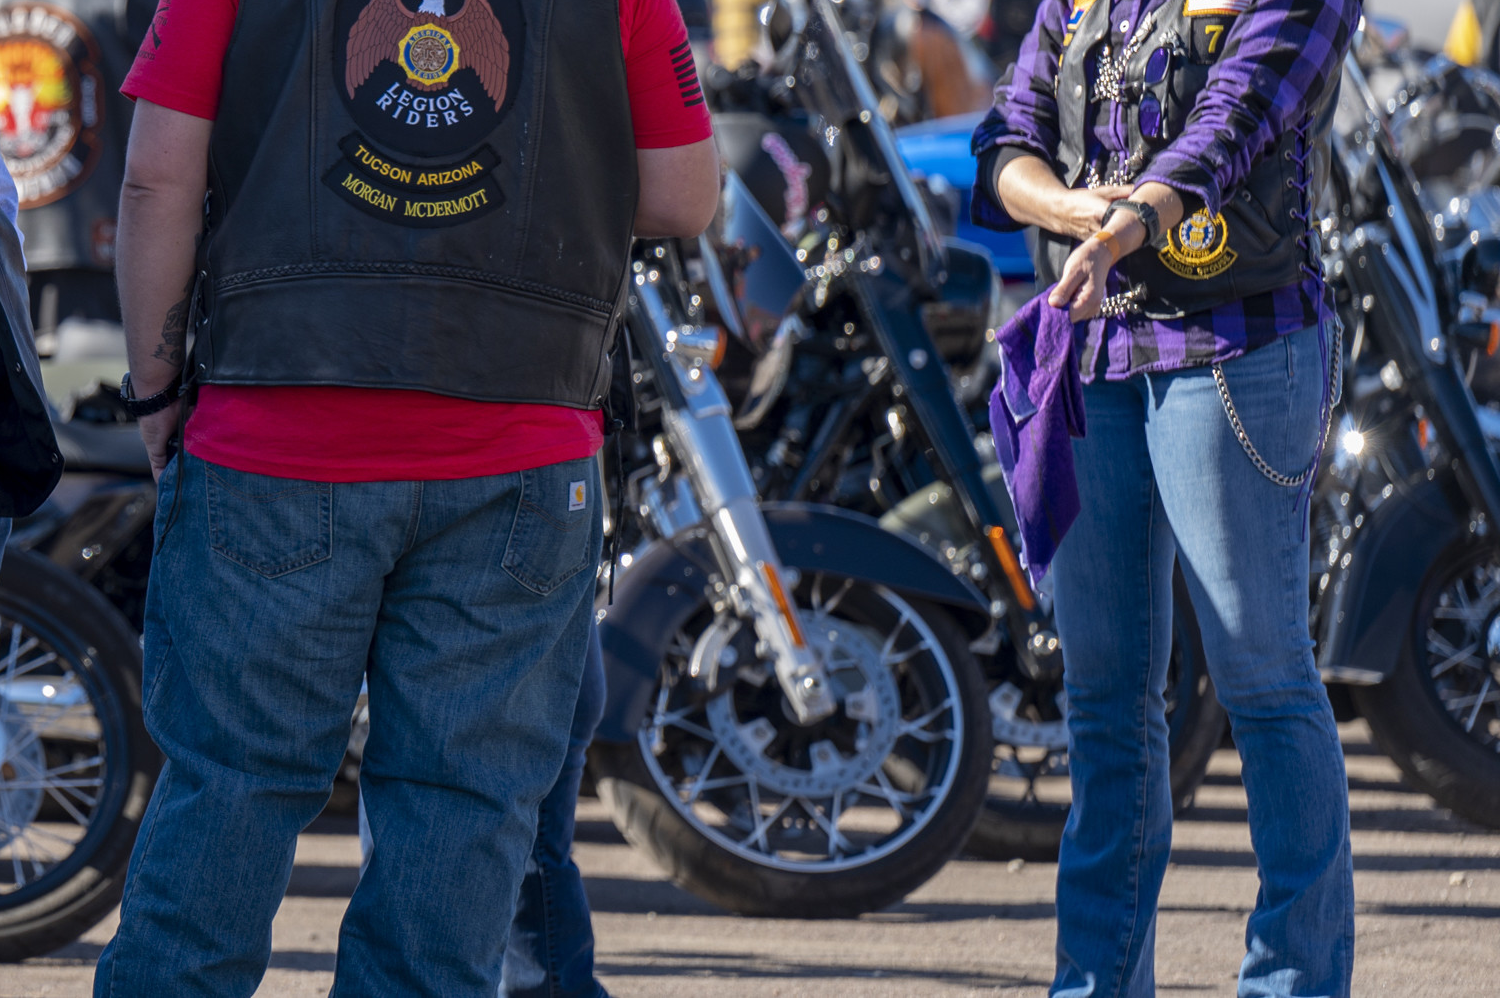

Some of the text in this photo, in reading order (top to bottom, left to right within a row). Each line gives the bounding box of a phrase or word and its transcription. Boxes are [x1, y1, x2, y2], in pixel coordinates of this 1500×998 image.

[408, 30, 452, 49] AMERICAN
[1204, 25, 1225, 53] 7
[413, 68, 444, 79] LEGION
[376, 92, 474, 128] RIDERS
[387, 82, 465, 113] LEGION
[355, 144, 483, 186] TUCSON ARIZONA
[341, 173, 489, 218] MORGAN MCDERMOTT
